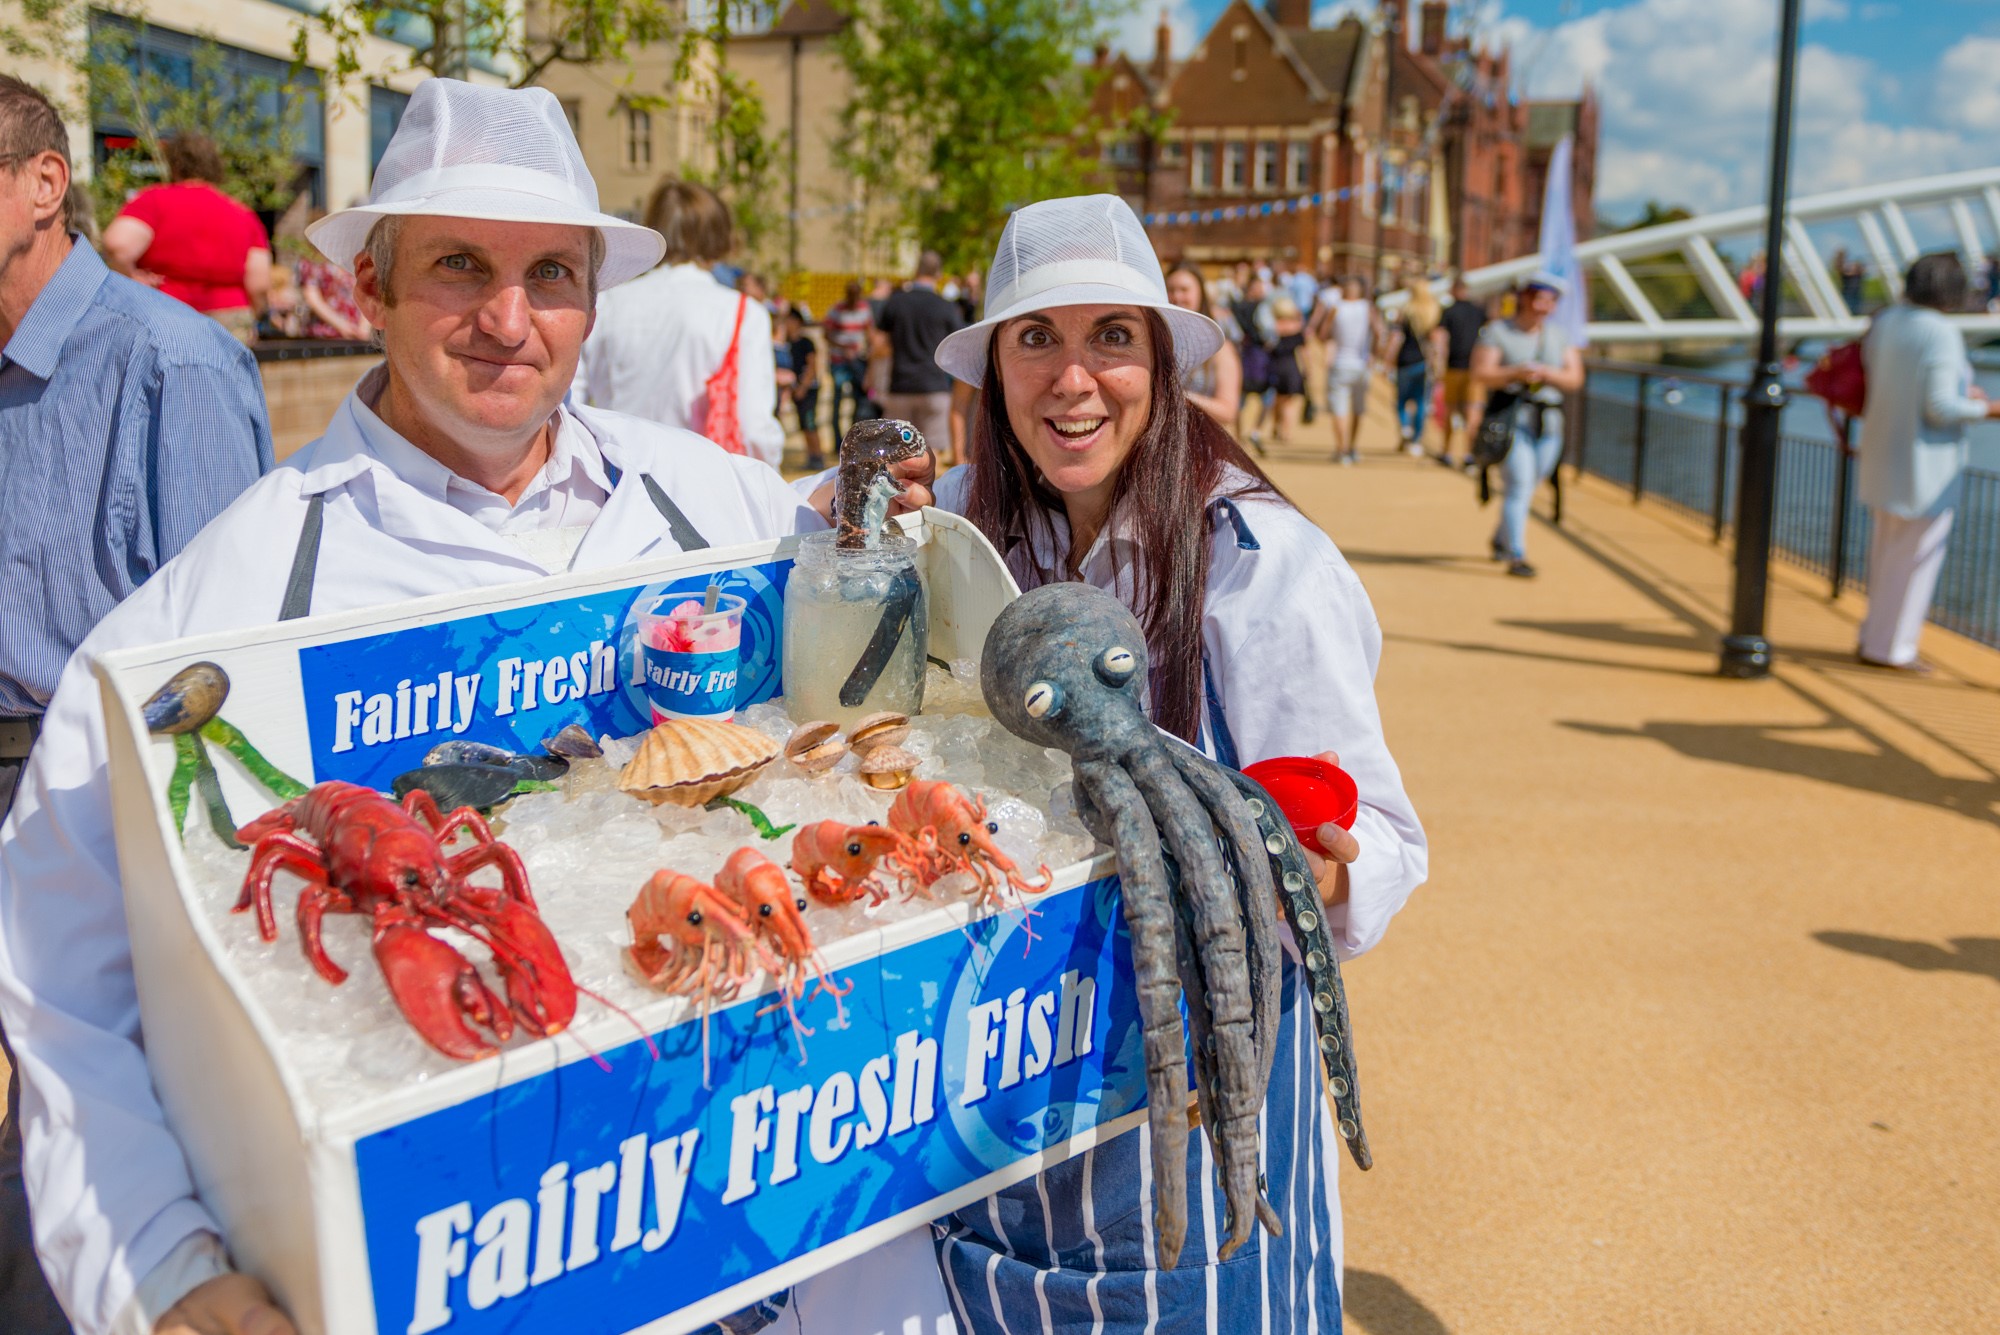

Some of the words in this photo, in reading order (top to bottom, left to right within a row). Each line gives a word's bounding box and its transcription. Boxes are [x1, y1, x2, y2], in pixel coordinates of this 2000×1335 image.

[332, 670, 482, 753] Fairly
[495, 640, 616, 717] Fresh
[646, 657, 702, 696] Fairly
[407, 1129, 700, 1335] Fairly
[722, 1029, 939, 1205] Fresh
[960, 968, 1097, 1106] Fish
